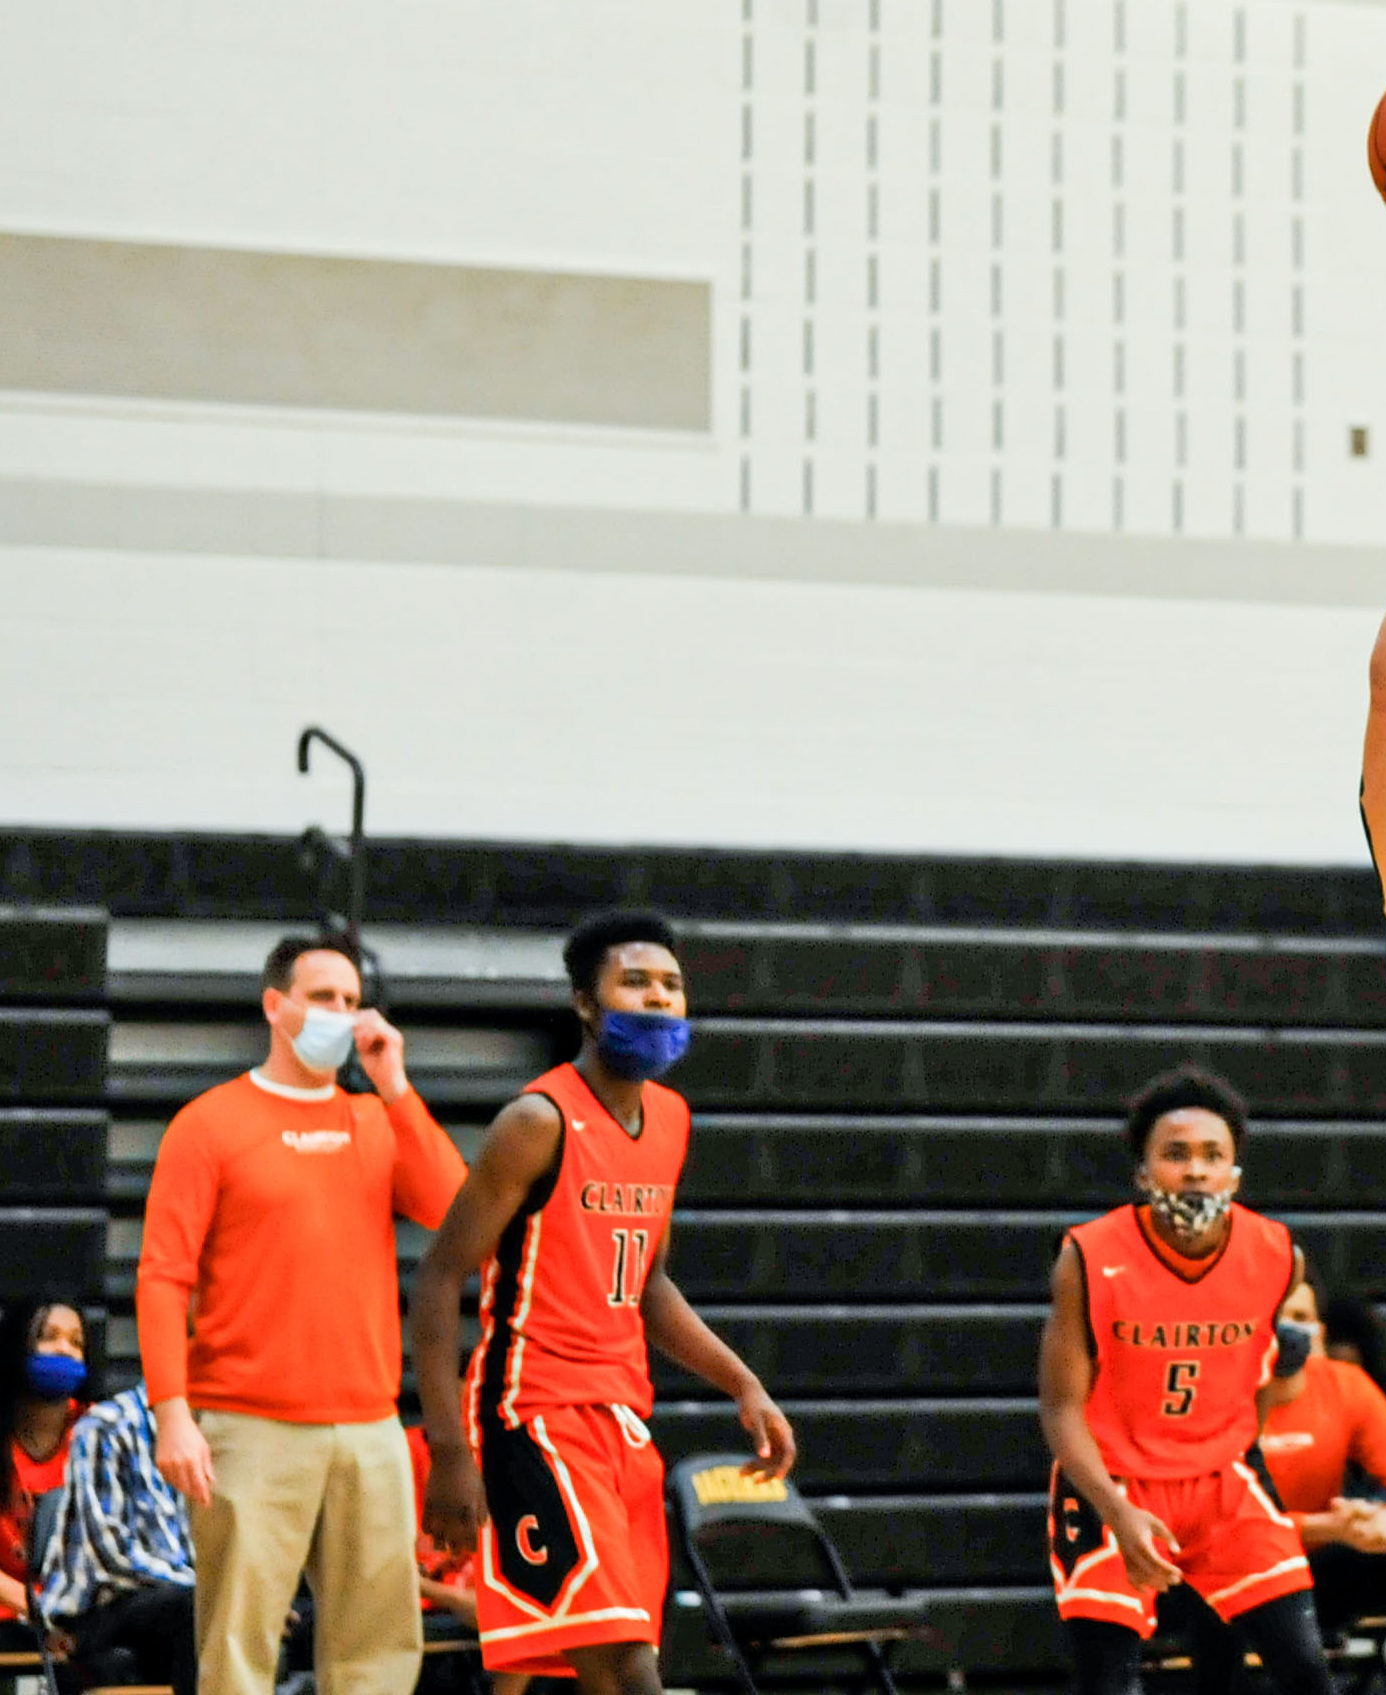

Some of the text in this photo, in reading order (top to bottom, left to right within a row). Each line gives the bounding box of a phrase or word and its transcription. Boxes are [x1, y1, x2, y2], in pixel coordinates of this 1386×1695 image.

[607, 1228, 648, 1308] 11
[1161, 1359, 1200, 1420] 5
[515, 1514, 548, 1565] C
